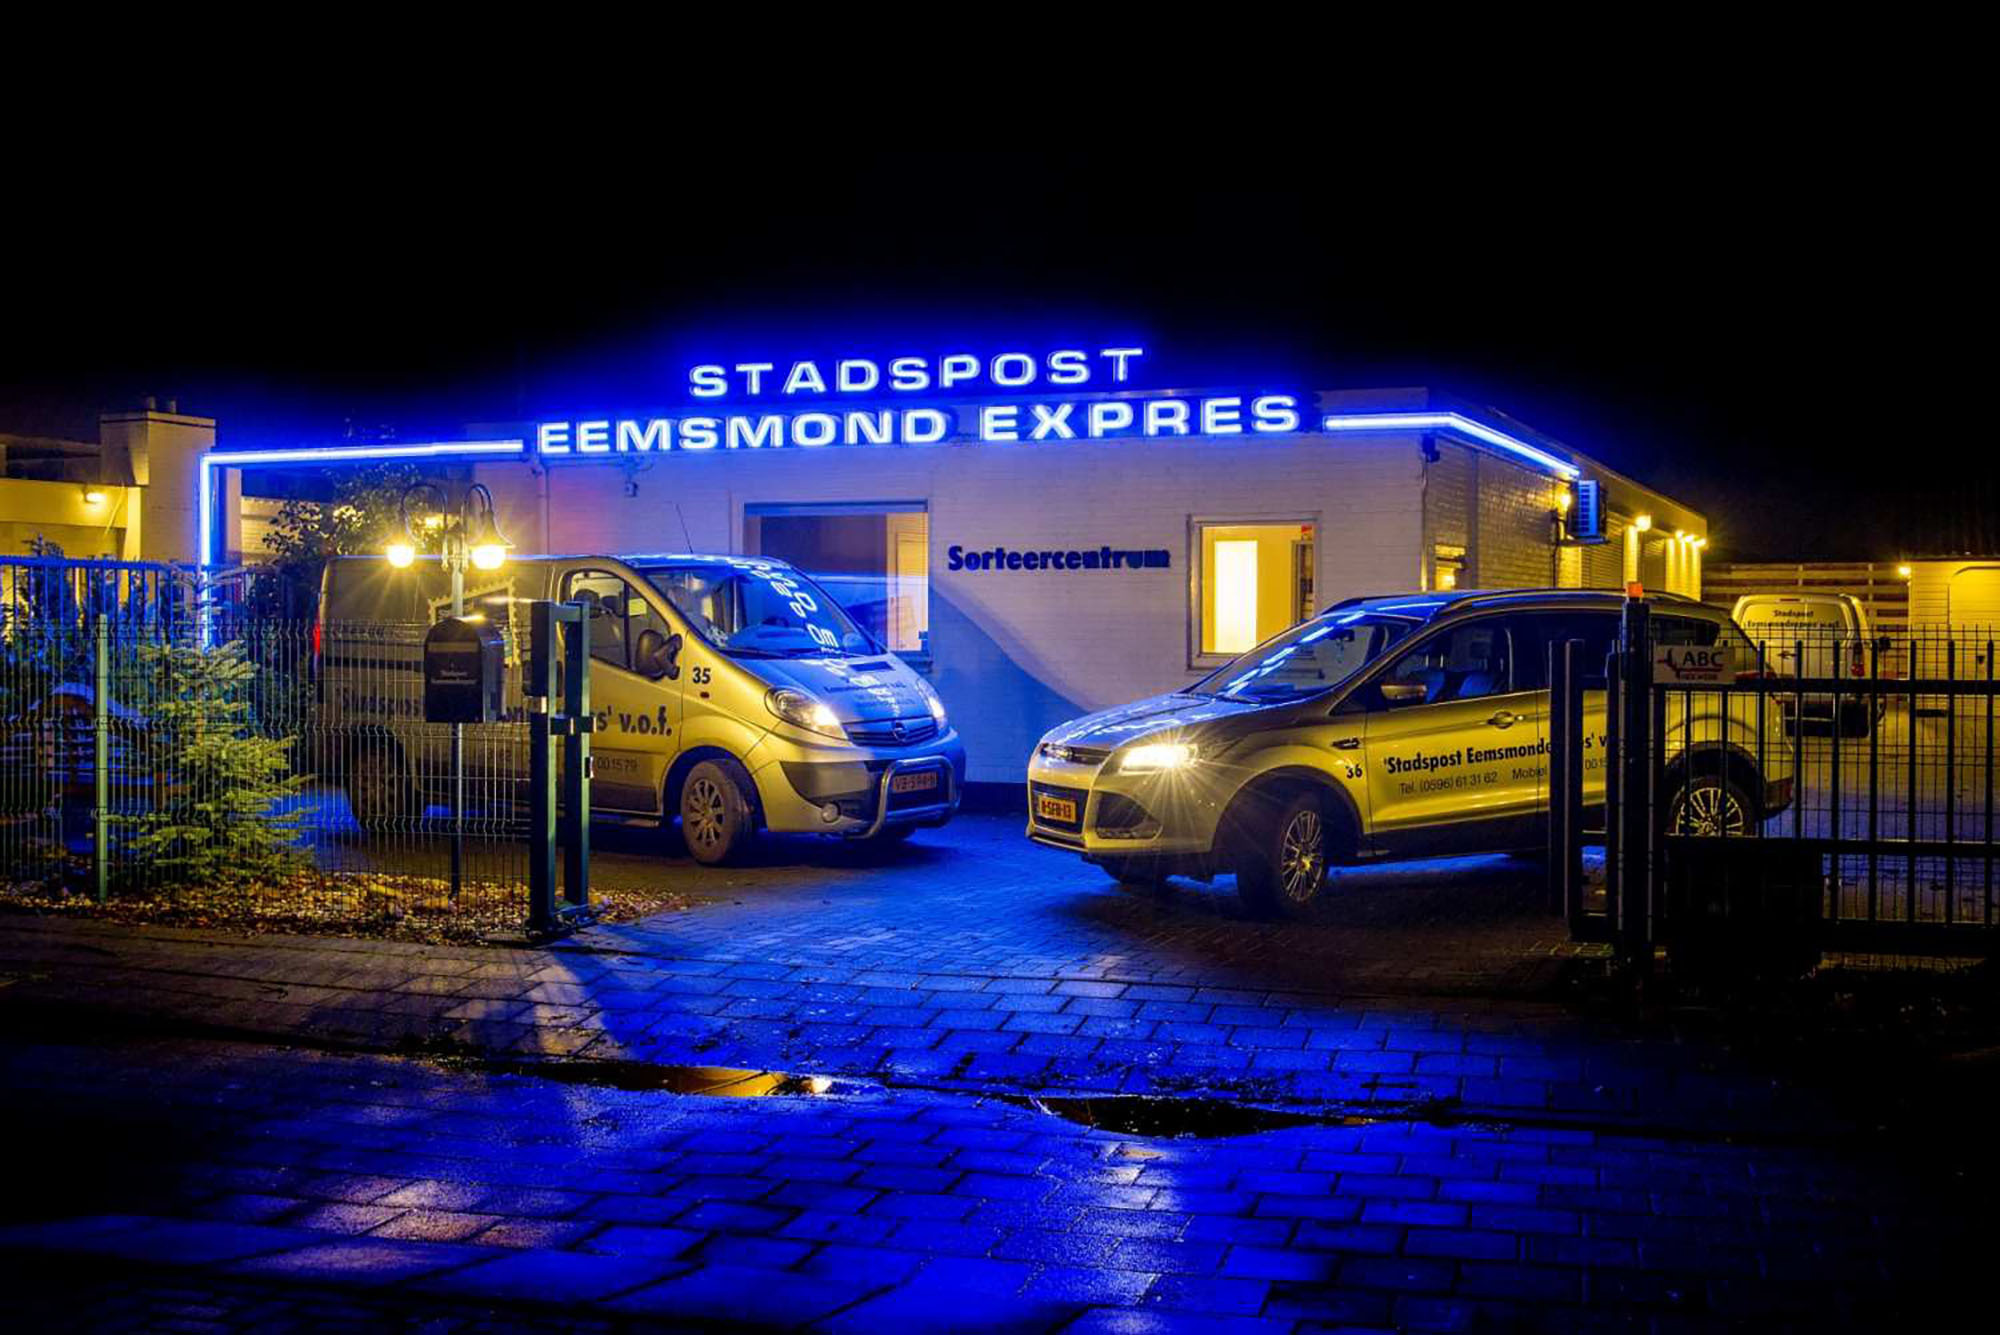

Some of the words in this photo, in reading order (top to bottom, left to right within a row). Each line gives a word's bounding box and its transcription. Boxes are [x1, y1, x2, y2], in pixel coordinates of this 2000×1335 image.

[690, 348, 1143, 397] STADSPOST
[538, 409, 948, 454] EEMSMOND
[980, 396, 1299, 441] EXPRES
[948, 545, 1171, 571] Sorteercentrum
[1682, 650, 1724, 667] ABC
[692, 667, 711, 684] 35
[619, 706, 672, 736] v.o.f.
[1346, 763, 1363, 779] 36
[1419, 776, 1454, 792] (0596)
[1471, 773, 1481, 785] 31
